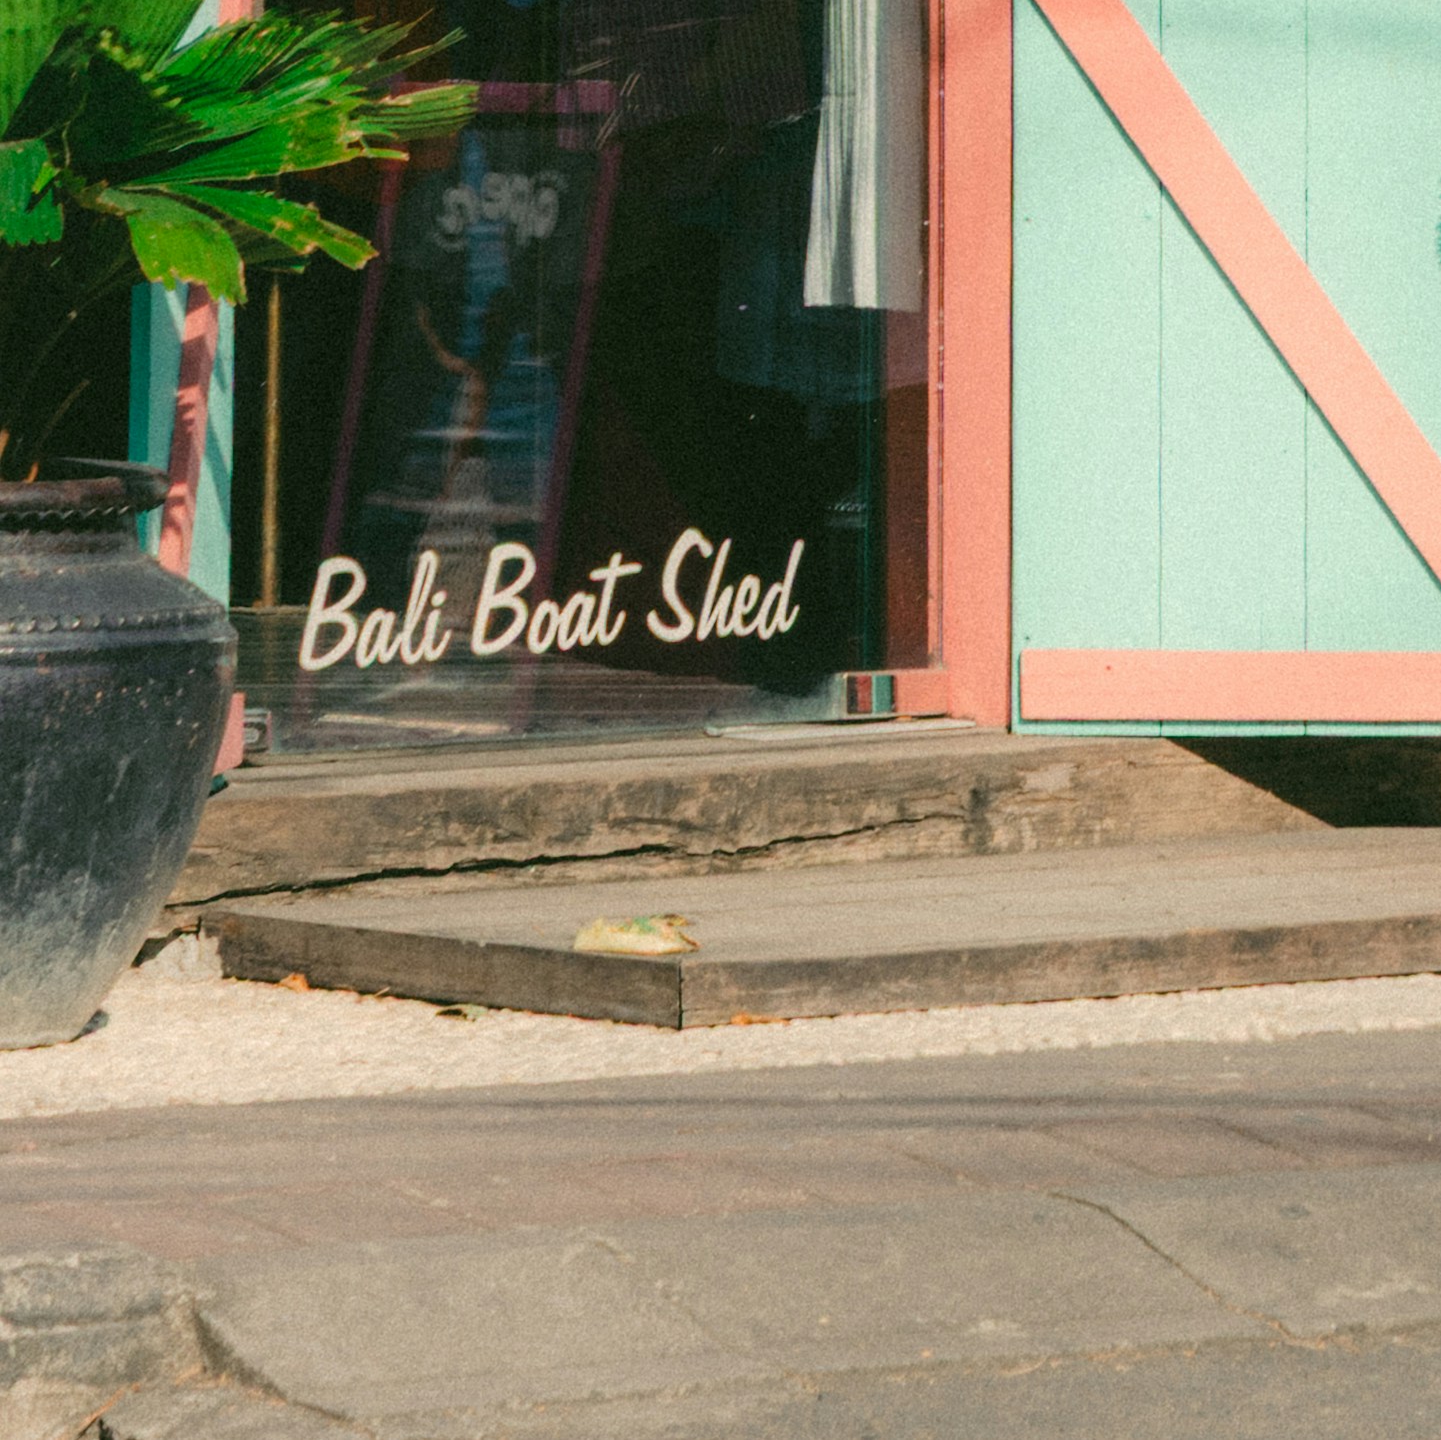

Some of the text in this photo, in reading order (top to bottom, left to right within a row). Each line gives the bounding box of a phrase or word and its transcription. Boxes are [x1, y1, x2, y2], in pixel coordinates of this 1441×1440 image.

[300, 528, 804, 672] Bali Boat Shed
